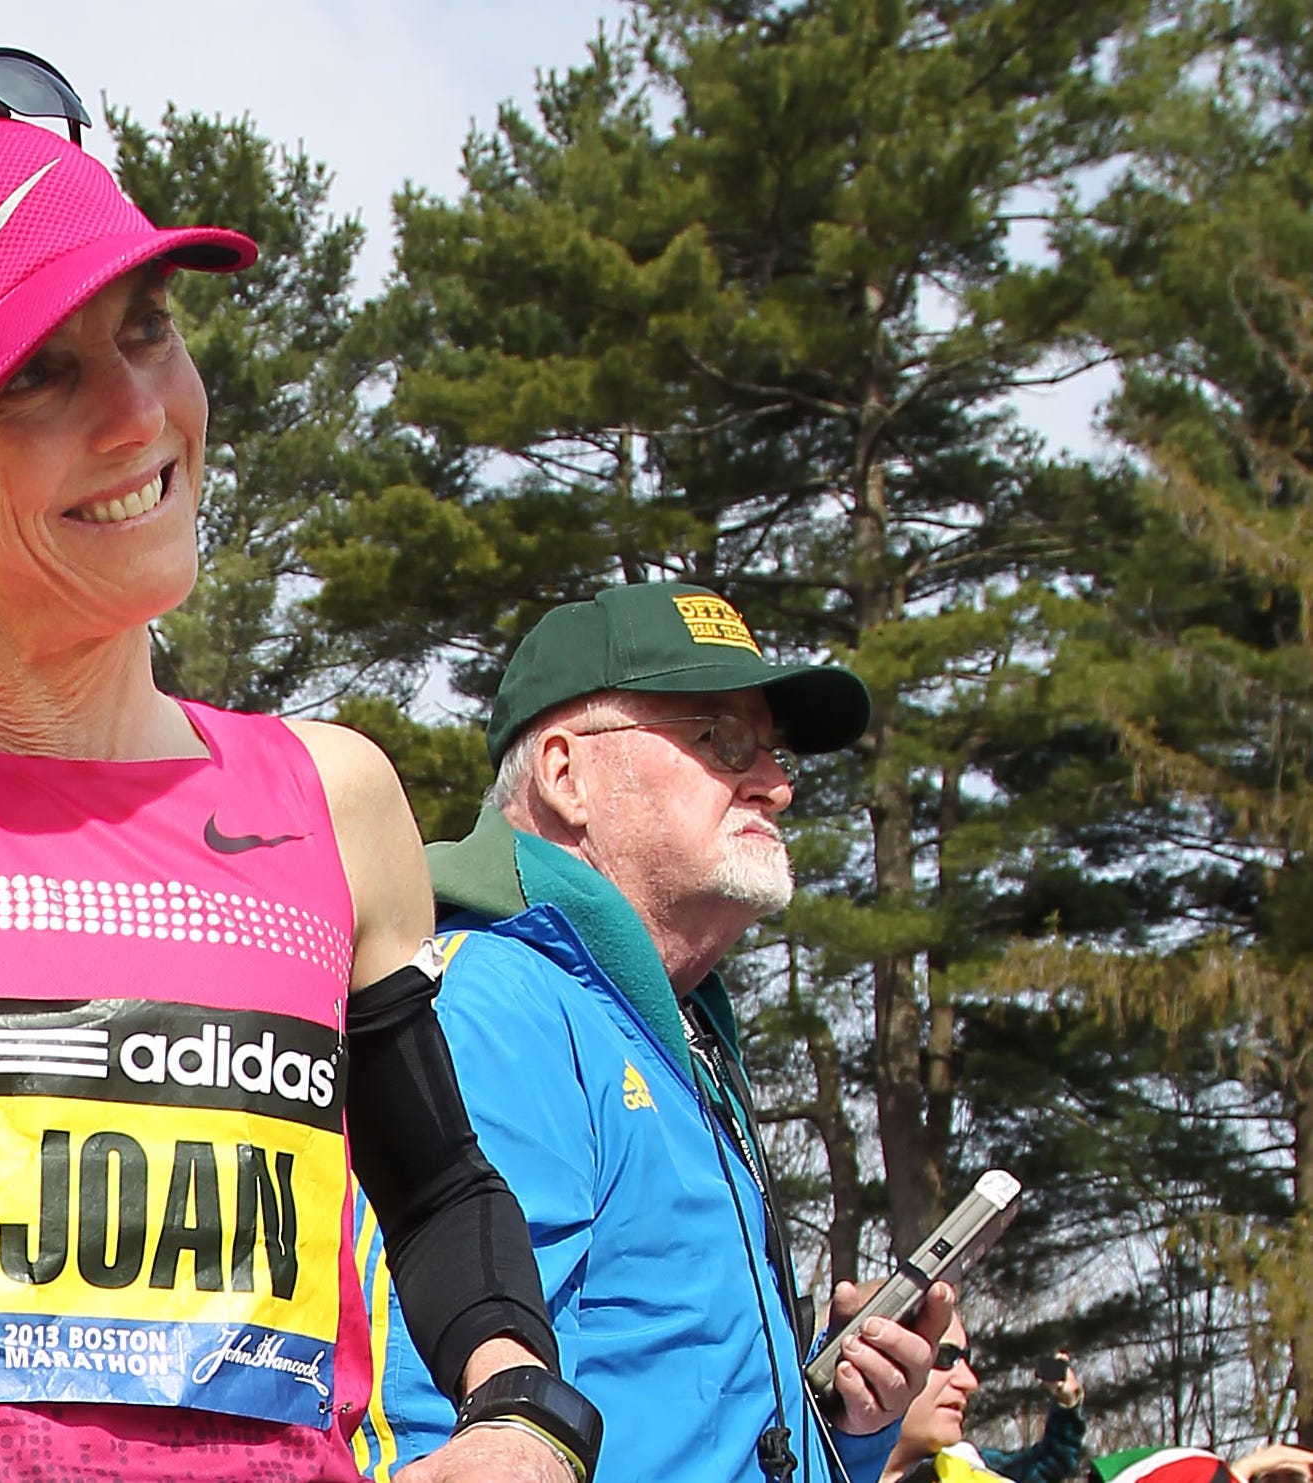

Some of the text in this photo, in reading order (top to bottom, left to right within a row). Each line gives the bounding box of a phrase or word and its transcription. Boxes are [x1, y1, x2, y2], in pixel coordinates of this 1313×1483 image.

[119, 1023, 335, 1107] adidas
[4, 1324, 60, 1349] 2013
[68, 1327, 167, 1353] BOSTON
[4, 1347, 170, 1376] MARATHON
